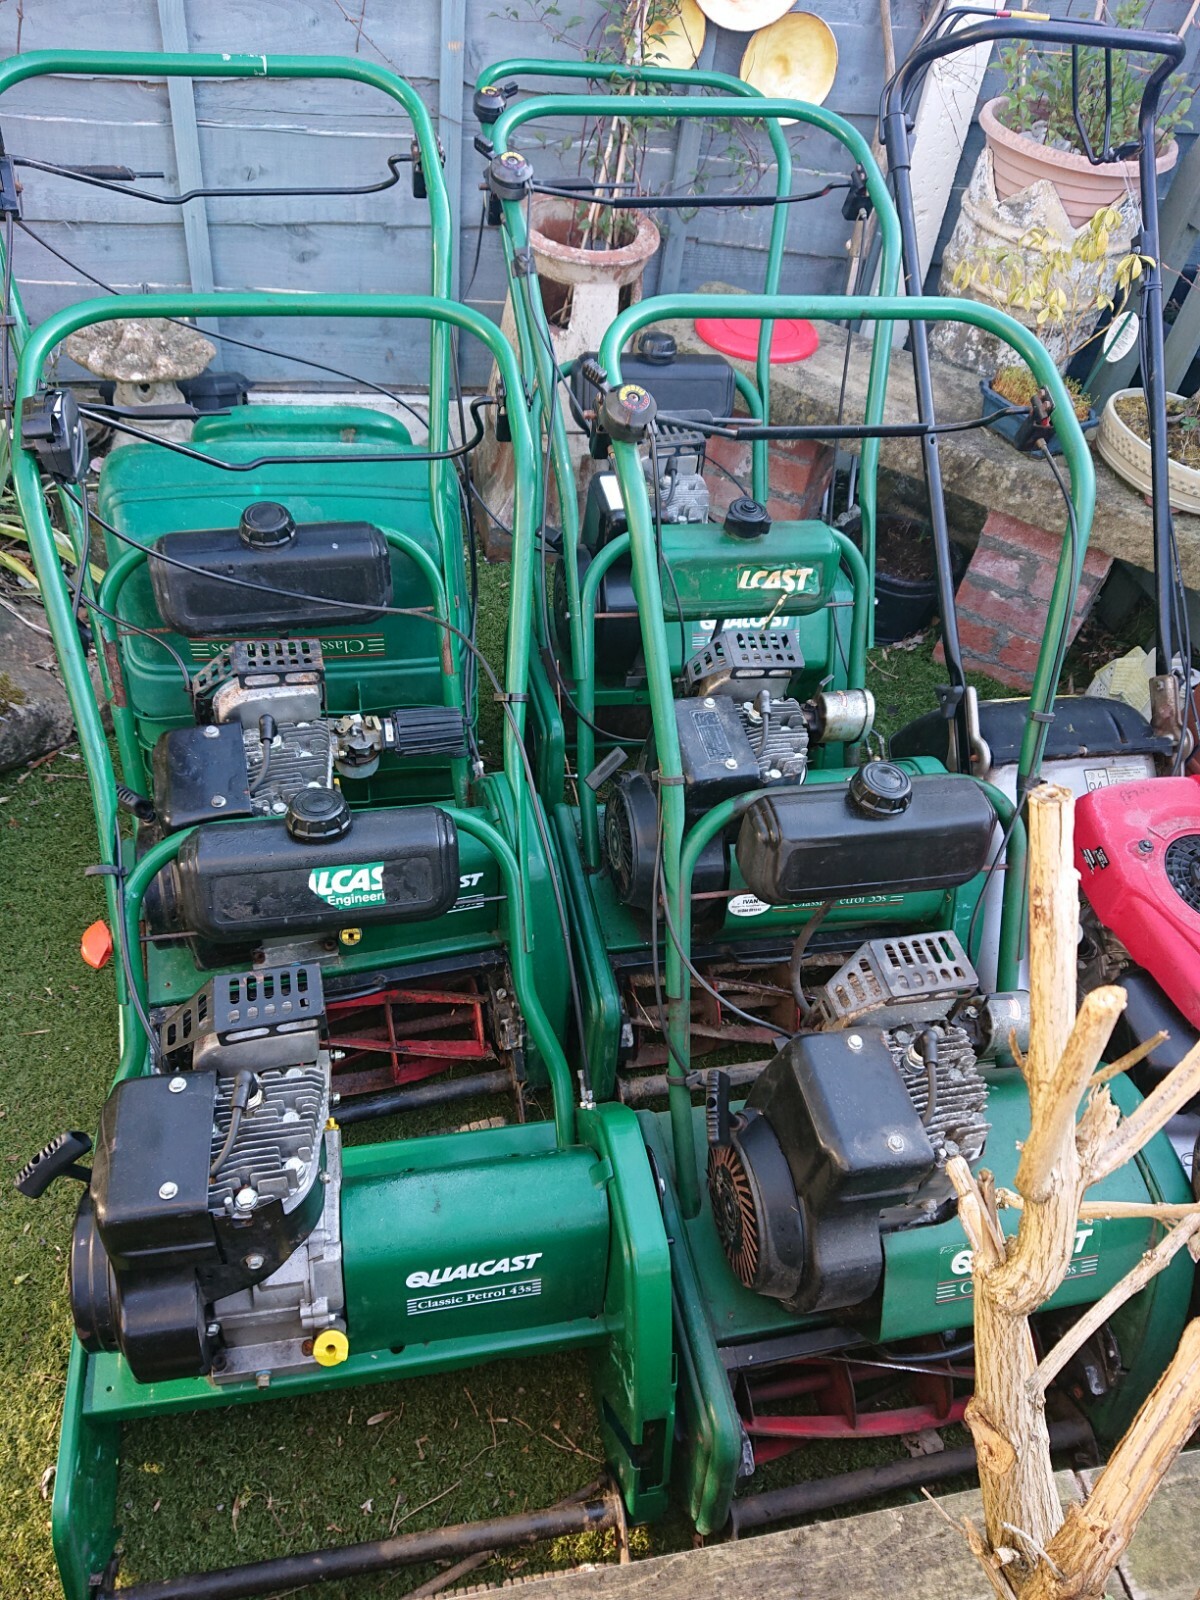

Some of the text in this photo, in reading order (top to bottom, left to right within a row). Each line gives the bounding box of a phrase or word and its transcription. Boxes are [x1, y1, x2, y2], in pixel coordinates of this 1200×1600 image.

[405, 1252, 543, 1289] QUALCAST
[417, 1285, 532, 1310] Classic Petrol 43s
